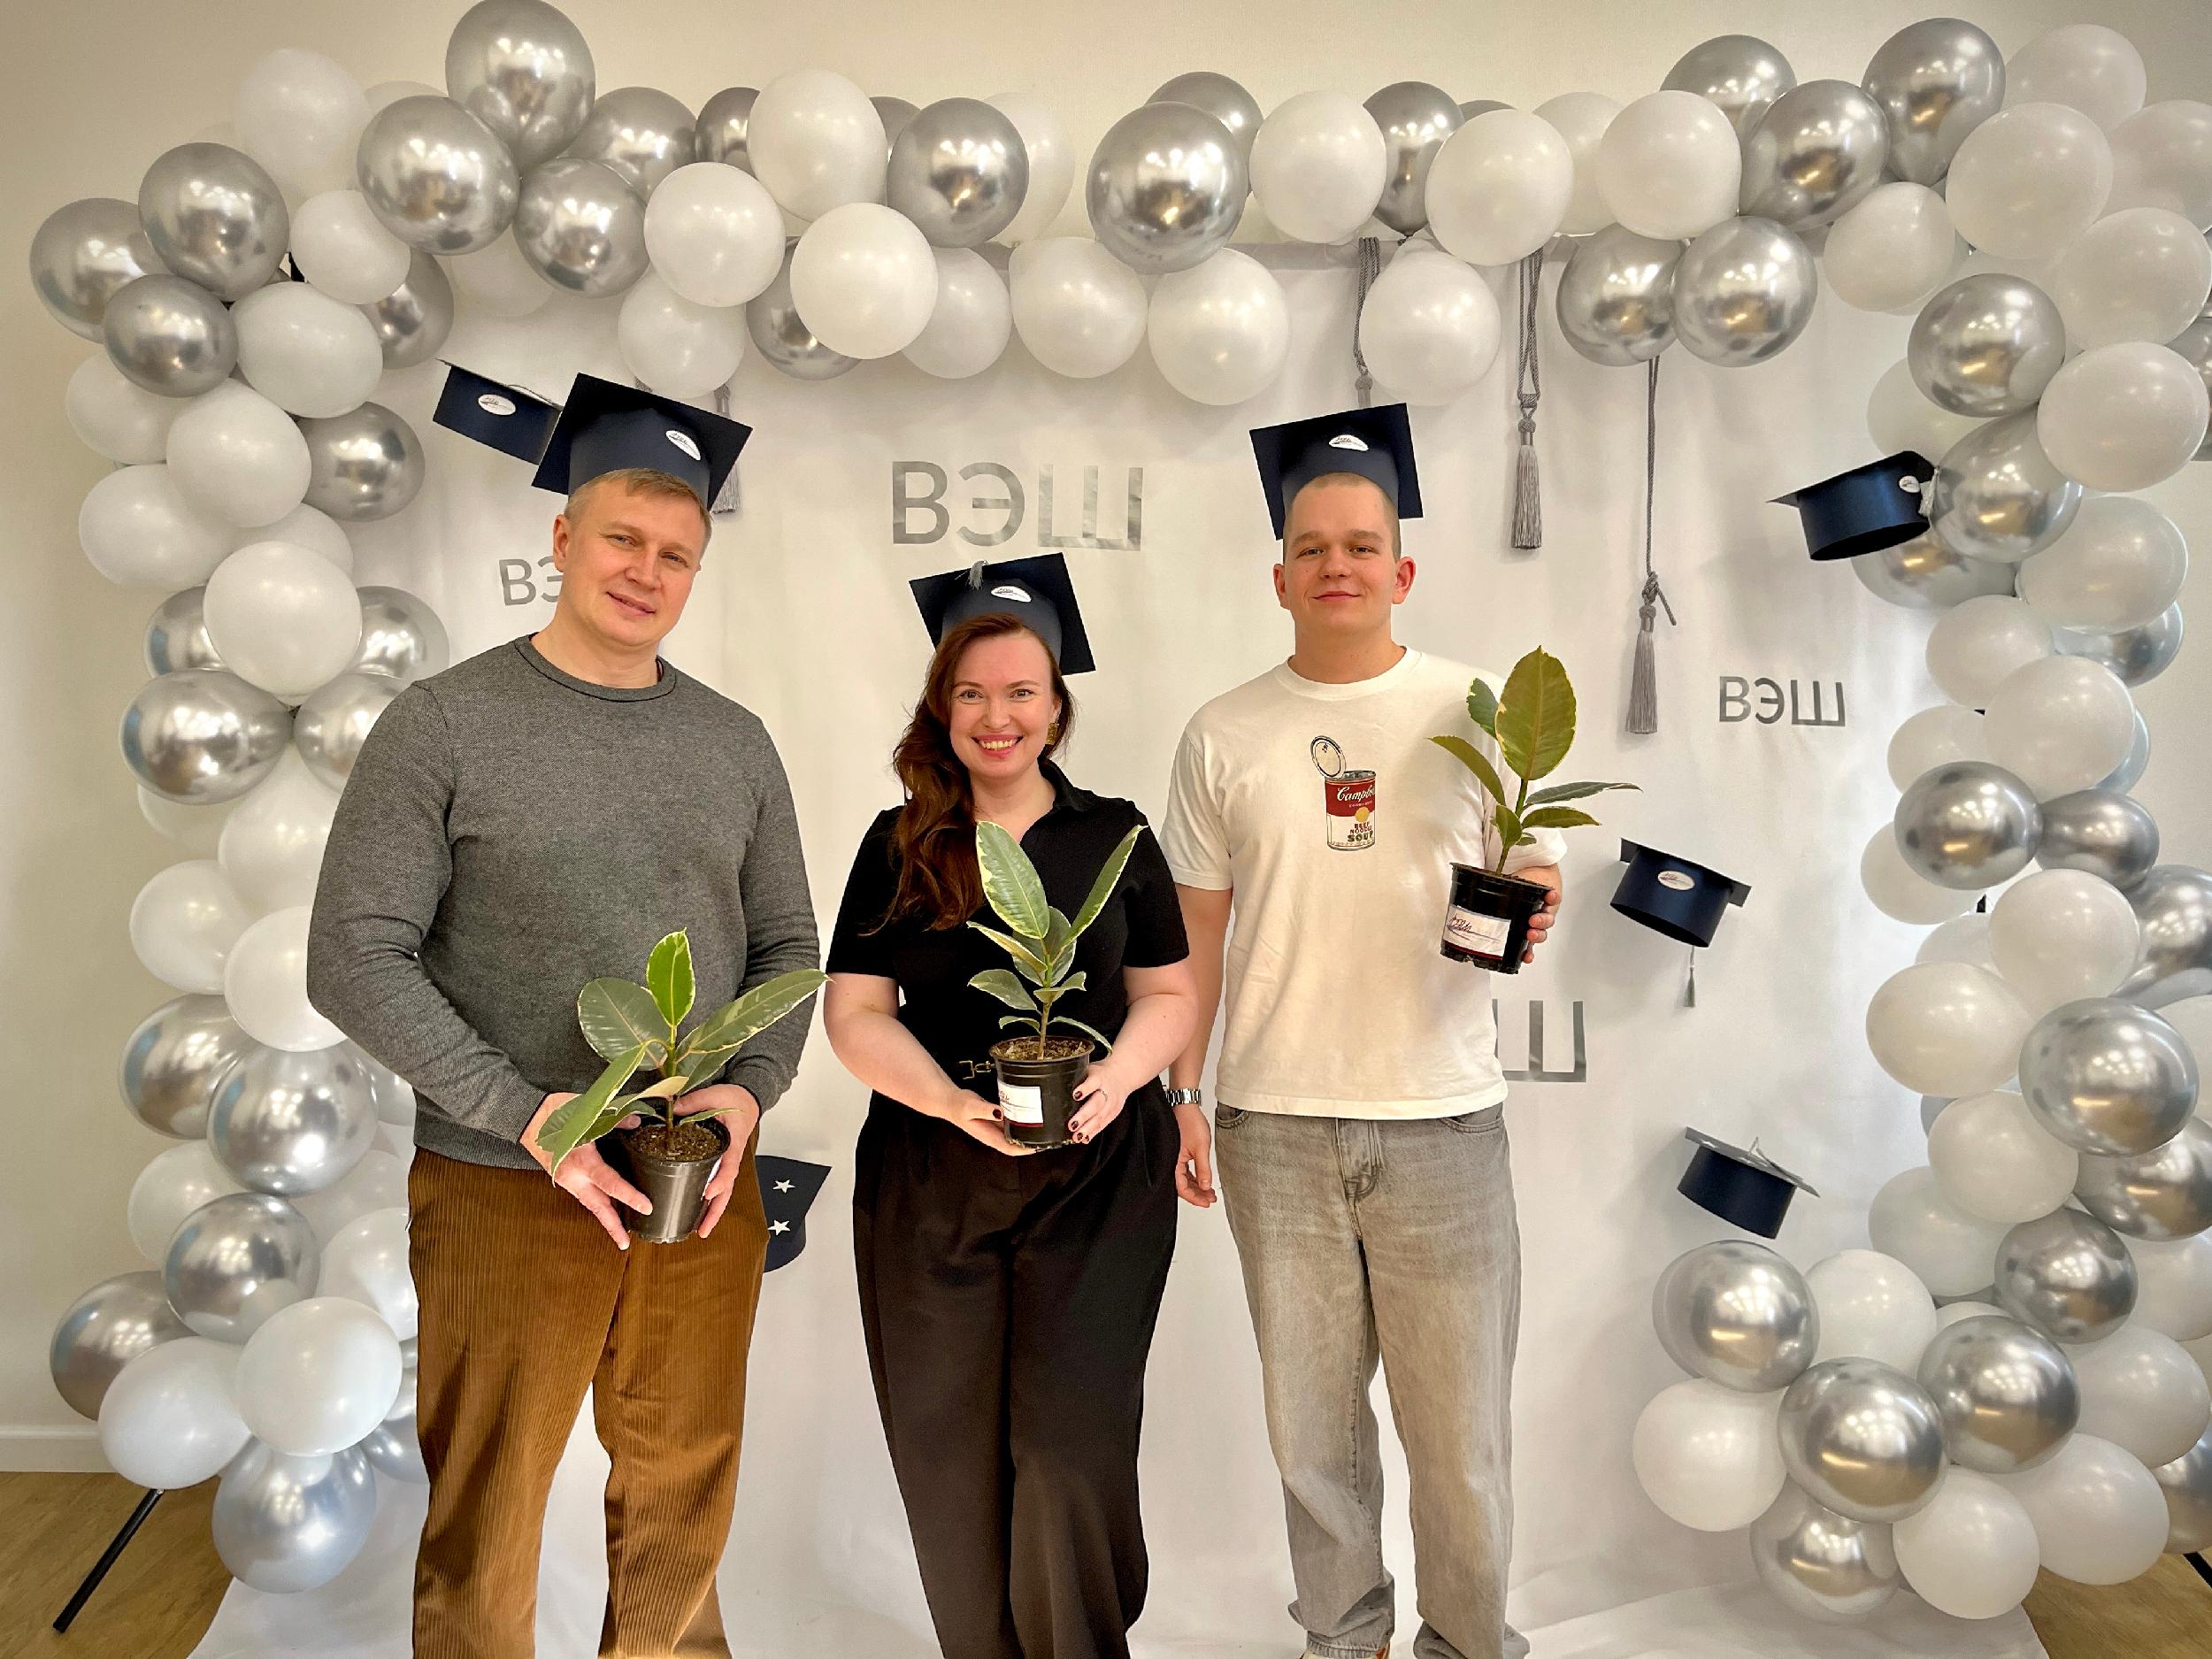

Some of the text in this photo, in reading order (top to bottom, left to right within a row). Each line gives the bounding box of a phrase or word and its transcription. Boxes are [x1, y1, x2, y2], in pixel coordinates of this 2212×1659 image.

[892, 461, 1144, 551] ВЭШ
[498, 556, 564, 606] ВЭ
[1719, 676, 1846, 726] ВЭШ
